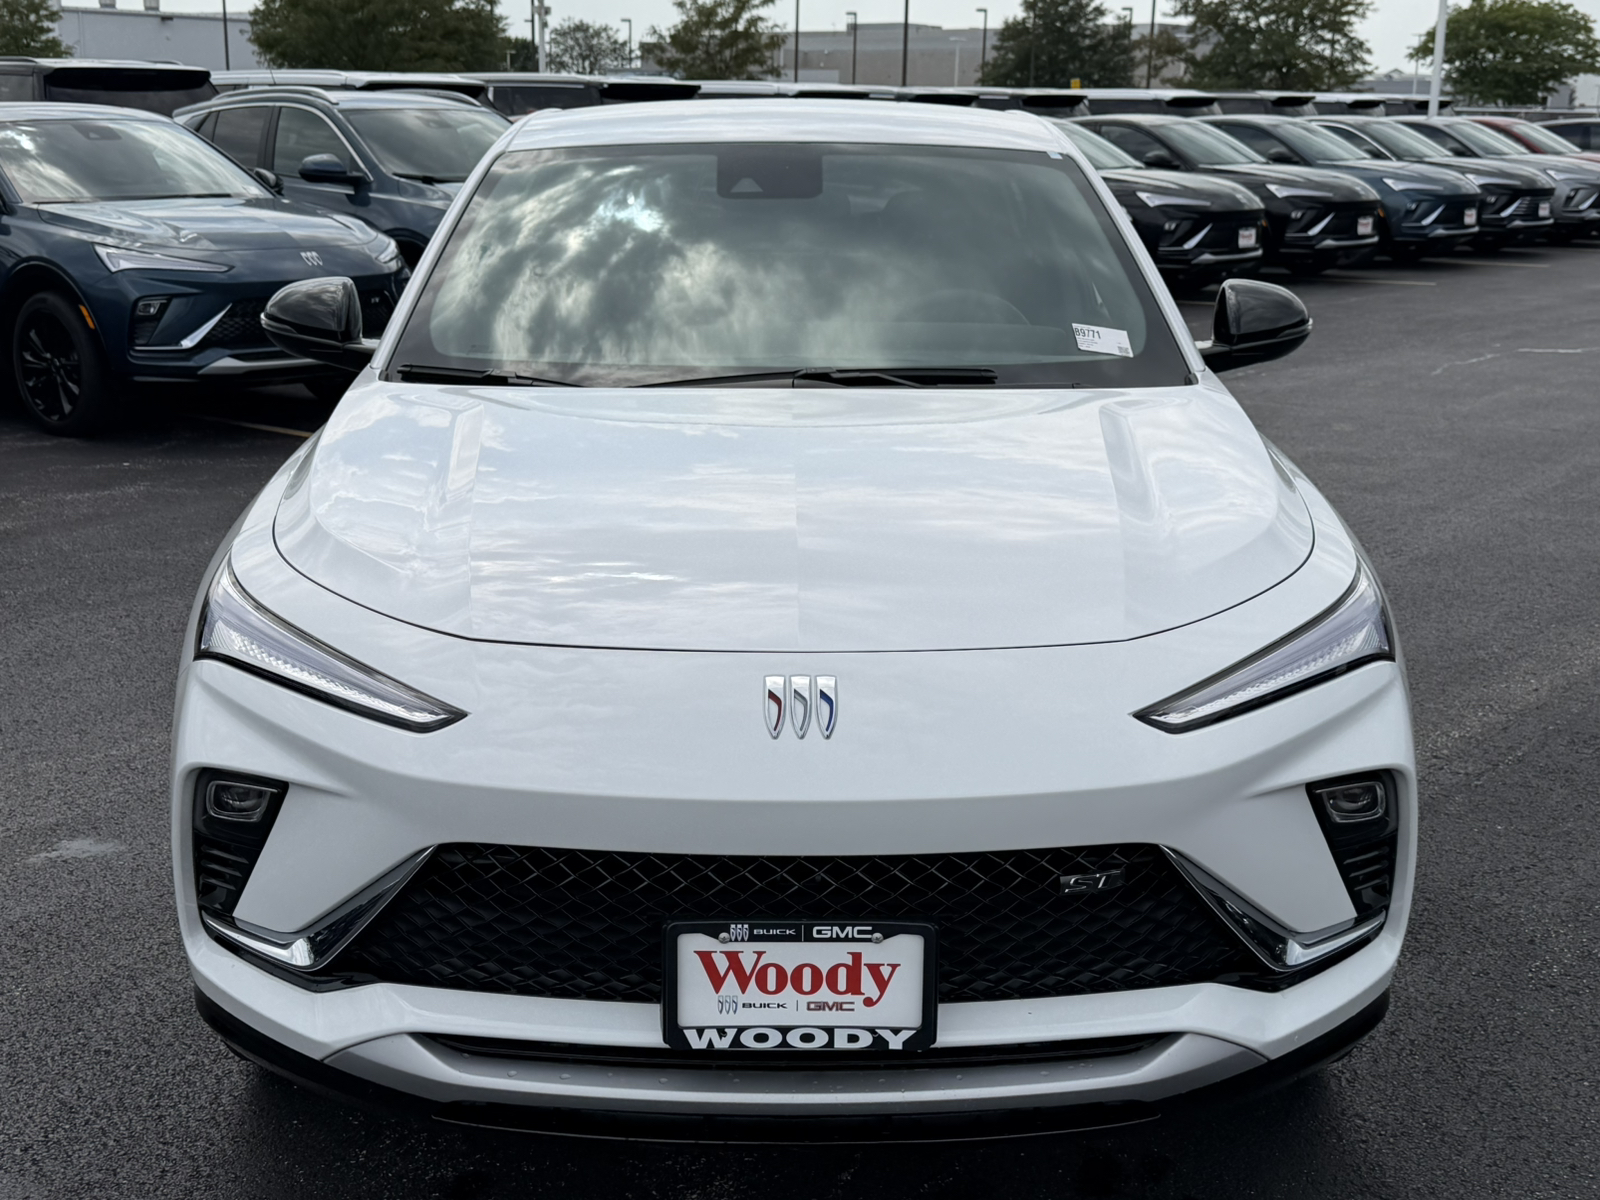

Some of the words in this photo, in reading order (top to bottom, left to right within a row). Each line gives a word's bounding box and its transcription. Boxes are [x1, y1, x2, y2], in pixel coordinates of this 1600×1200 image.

[812, 926, 873, 939] GMC
[693, 950, 901, 1008] Woody
[806, 1001, 855, 1011] GMC
[682, 1027, 917, 1050] WOODY
